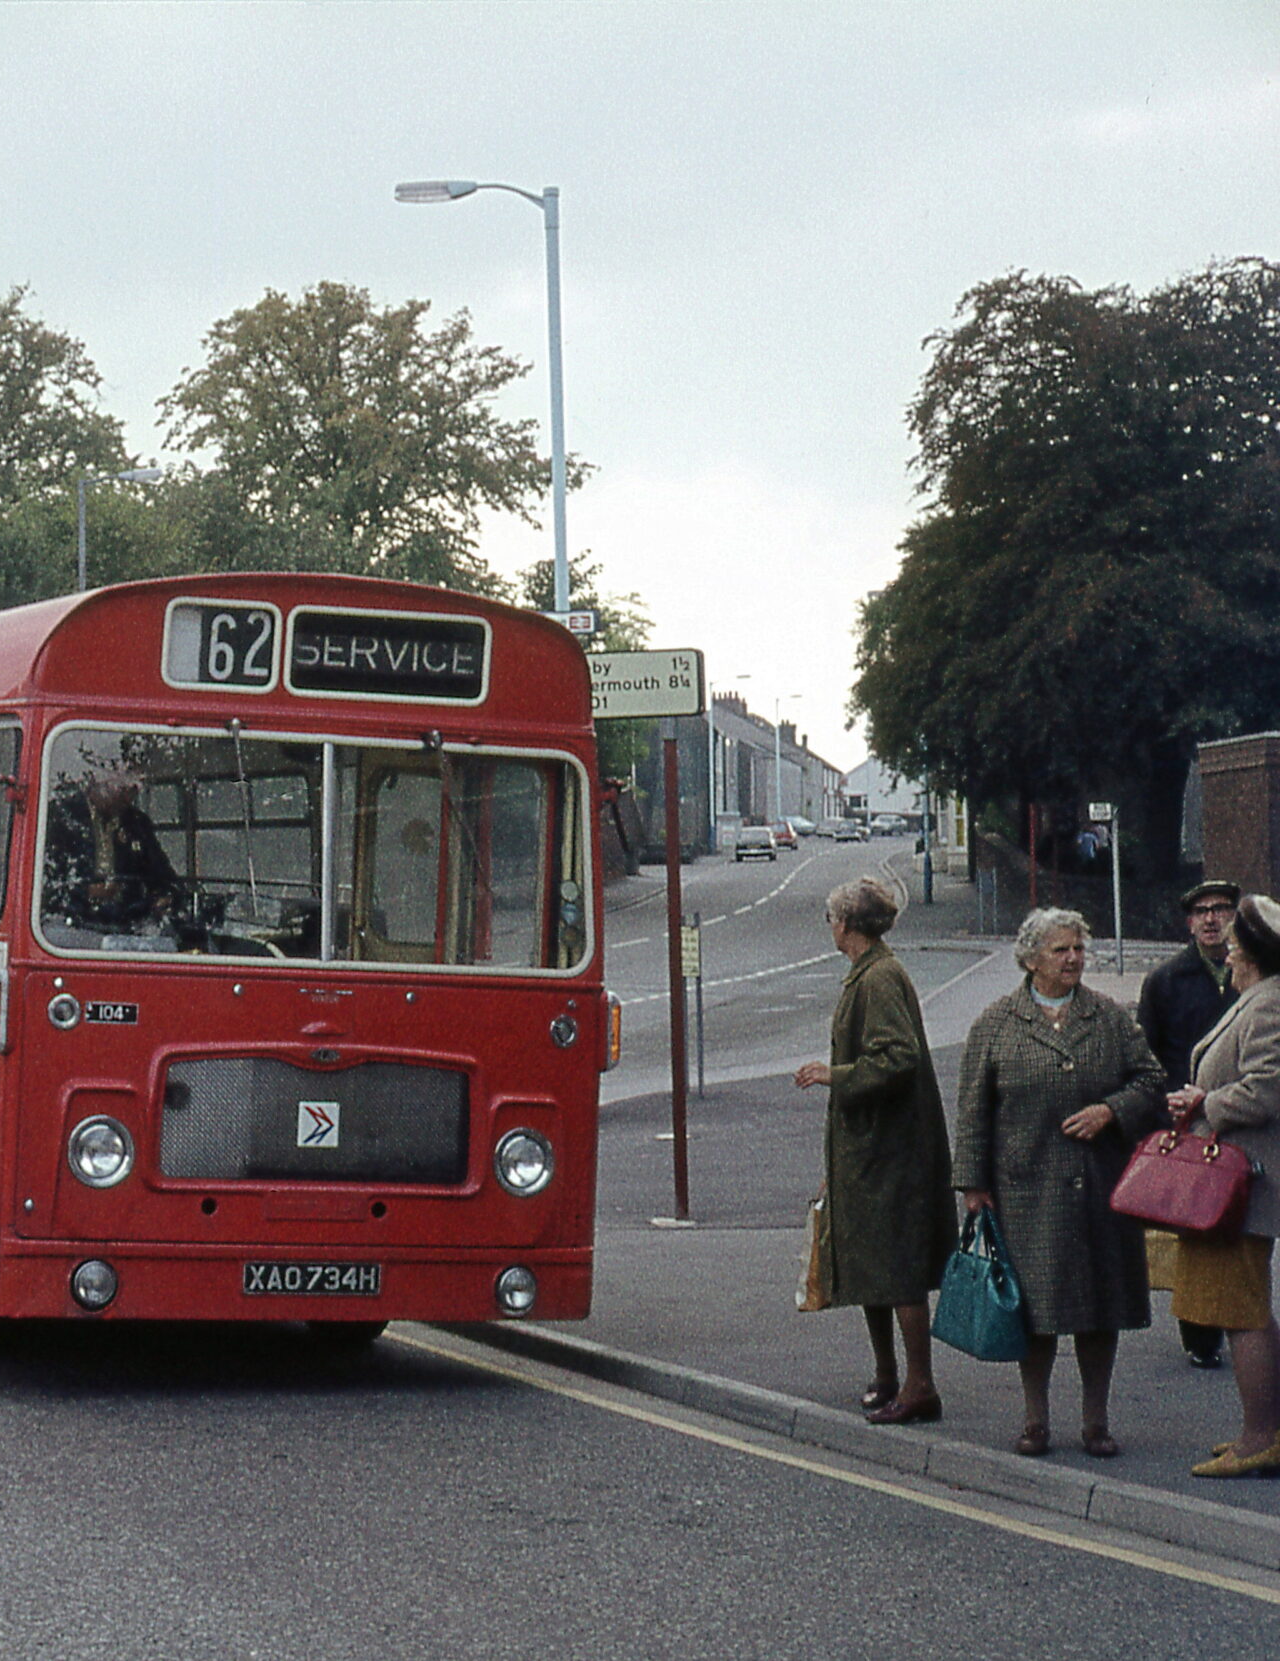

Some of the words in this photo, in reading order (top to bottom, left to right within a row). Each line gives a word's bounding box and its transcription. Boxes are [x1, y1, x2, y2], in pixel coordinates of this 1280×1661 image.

[208, 611, 271, 681] 62
[295, 634, 475, 676] SERVICE
[592, 661, 612, 676] by
[591, 677, 660, 692] ermouth
